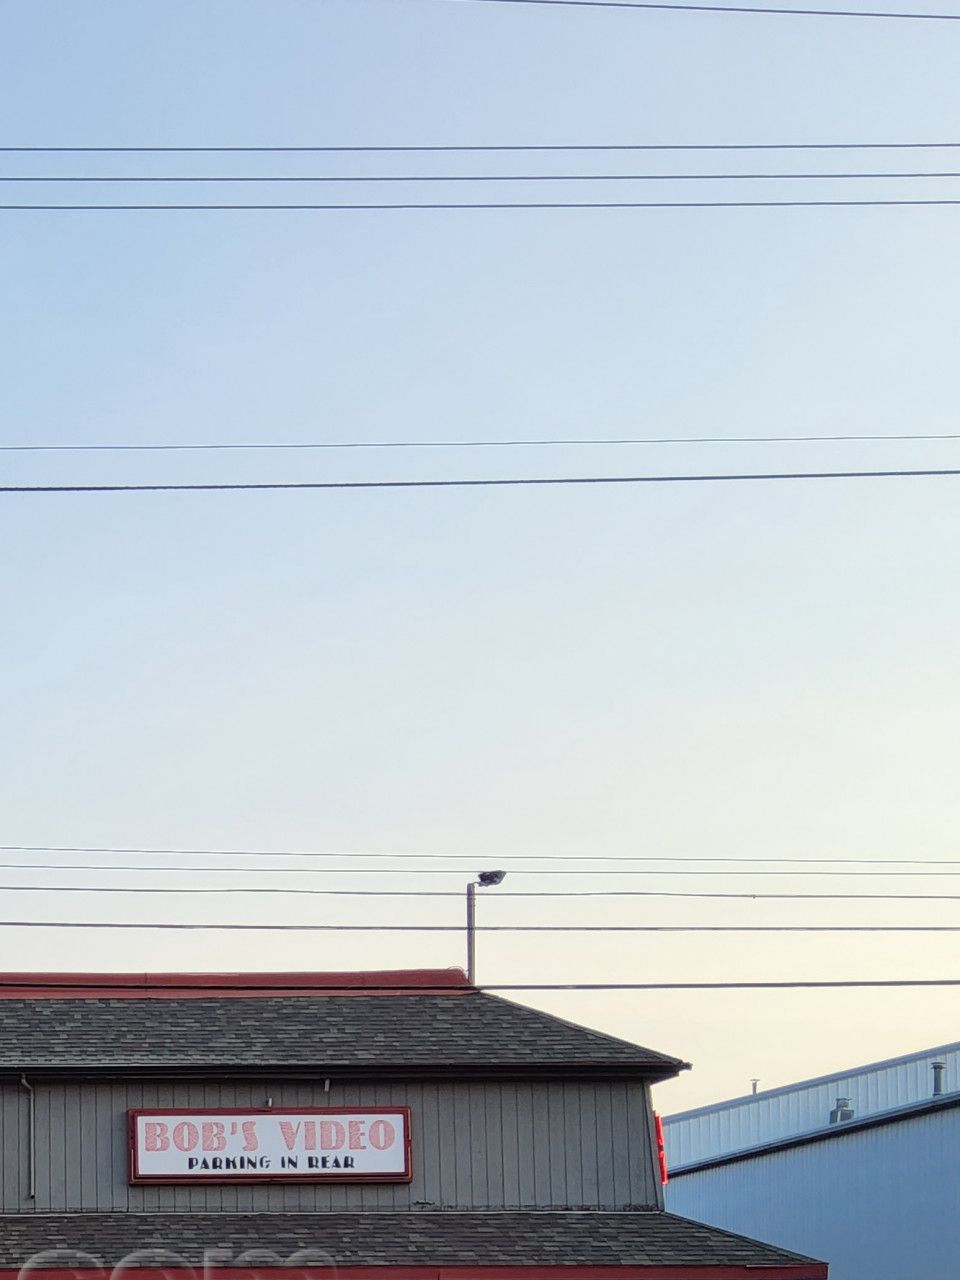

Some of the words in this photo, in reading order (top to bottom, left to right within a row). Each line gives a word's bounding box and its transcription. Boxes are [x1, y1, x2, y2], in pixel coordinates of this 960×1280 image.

[144, 1121, 259, 1151] BOB'S
[279, 1120, 395, 1150] VIDEO
[188, 1156, 271, 1170] PARKING
[281, 1156, 298, 1169] IN
[308, 1155, 355, 1169] REAR
